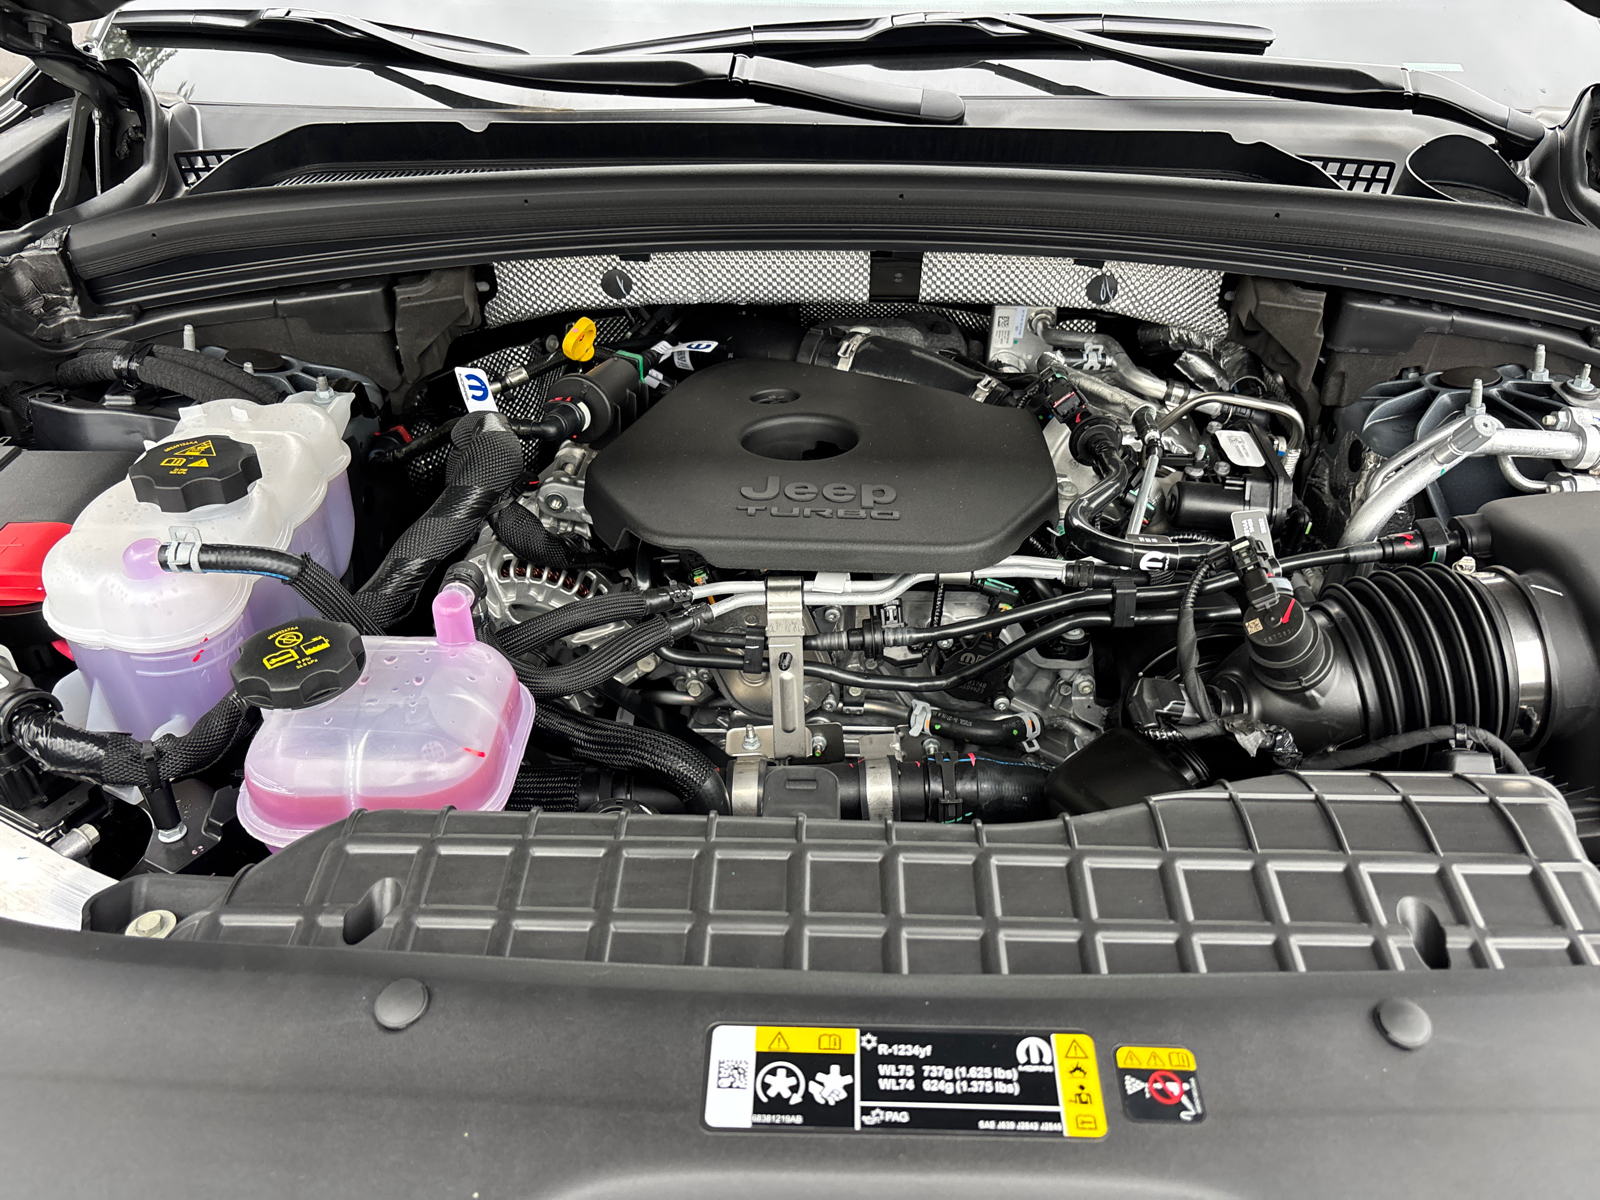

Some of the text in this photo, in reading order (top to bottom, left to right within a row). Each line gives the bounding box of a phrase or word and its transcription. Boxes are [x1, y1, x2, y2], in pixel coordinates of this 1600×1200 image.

[740, 475, 897, 509] Jeep
[736, 506, 901, 521] TURBO
[878, 1043, 932, 1058] R-1234yf
[878, 1063, 916, 1078] WL75
[922, 1064, 954, 1080] 737g
[954, 1065, 993, 1080] (1.625
[878, 1078, 916, 1092] WL74
[922, 1079, 954, 1095] 624g
[954, 1080, 994, 1095] (1.375
[885, 1110, 911, 1124] PAG
